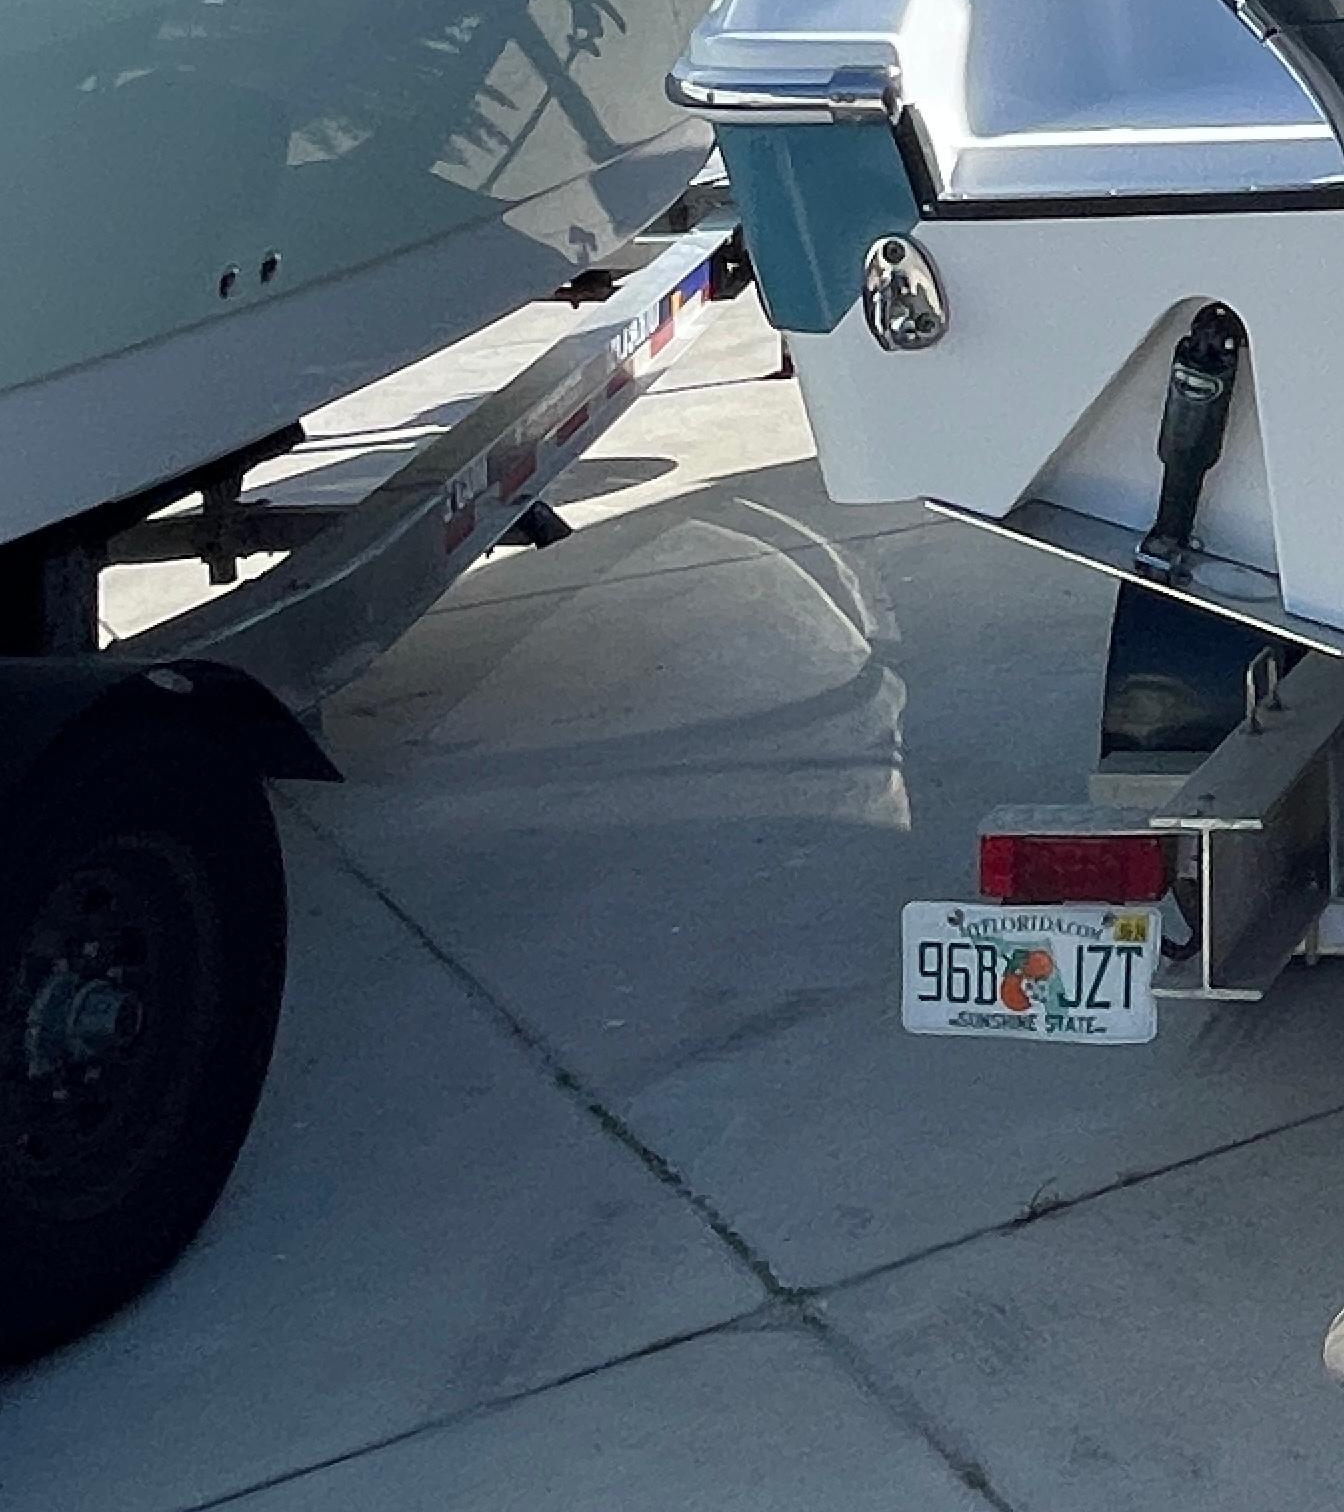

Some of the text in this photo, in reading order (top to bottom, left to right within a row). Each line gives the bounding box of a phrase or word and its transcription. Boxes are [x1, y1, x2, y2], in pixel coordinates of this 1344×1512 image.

[917, 941, 1144, 1010] 96B JZT
[1045, 1014, 1098, 1034] STATE
